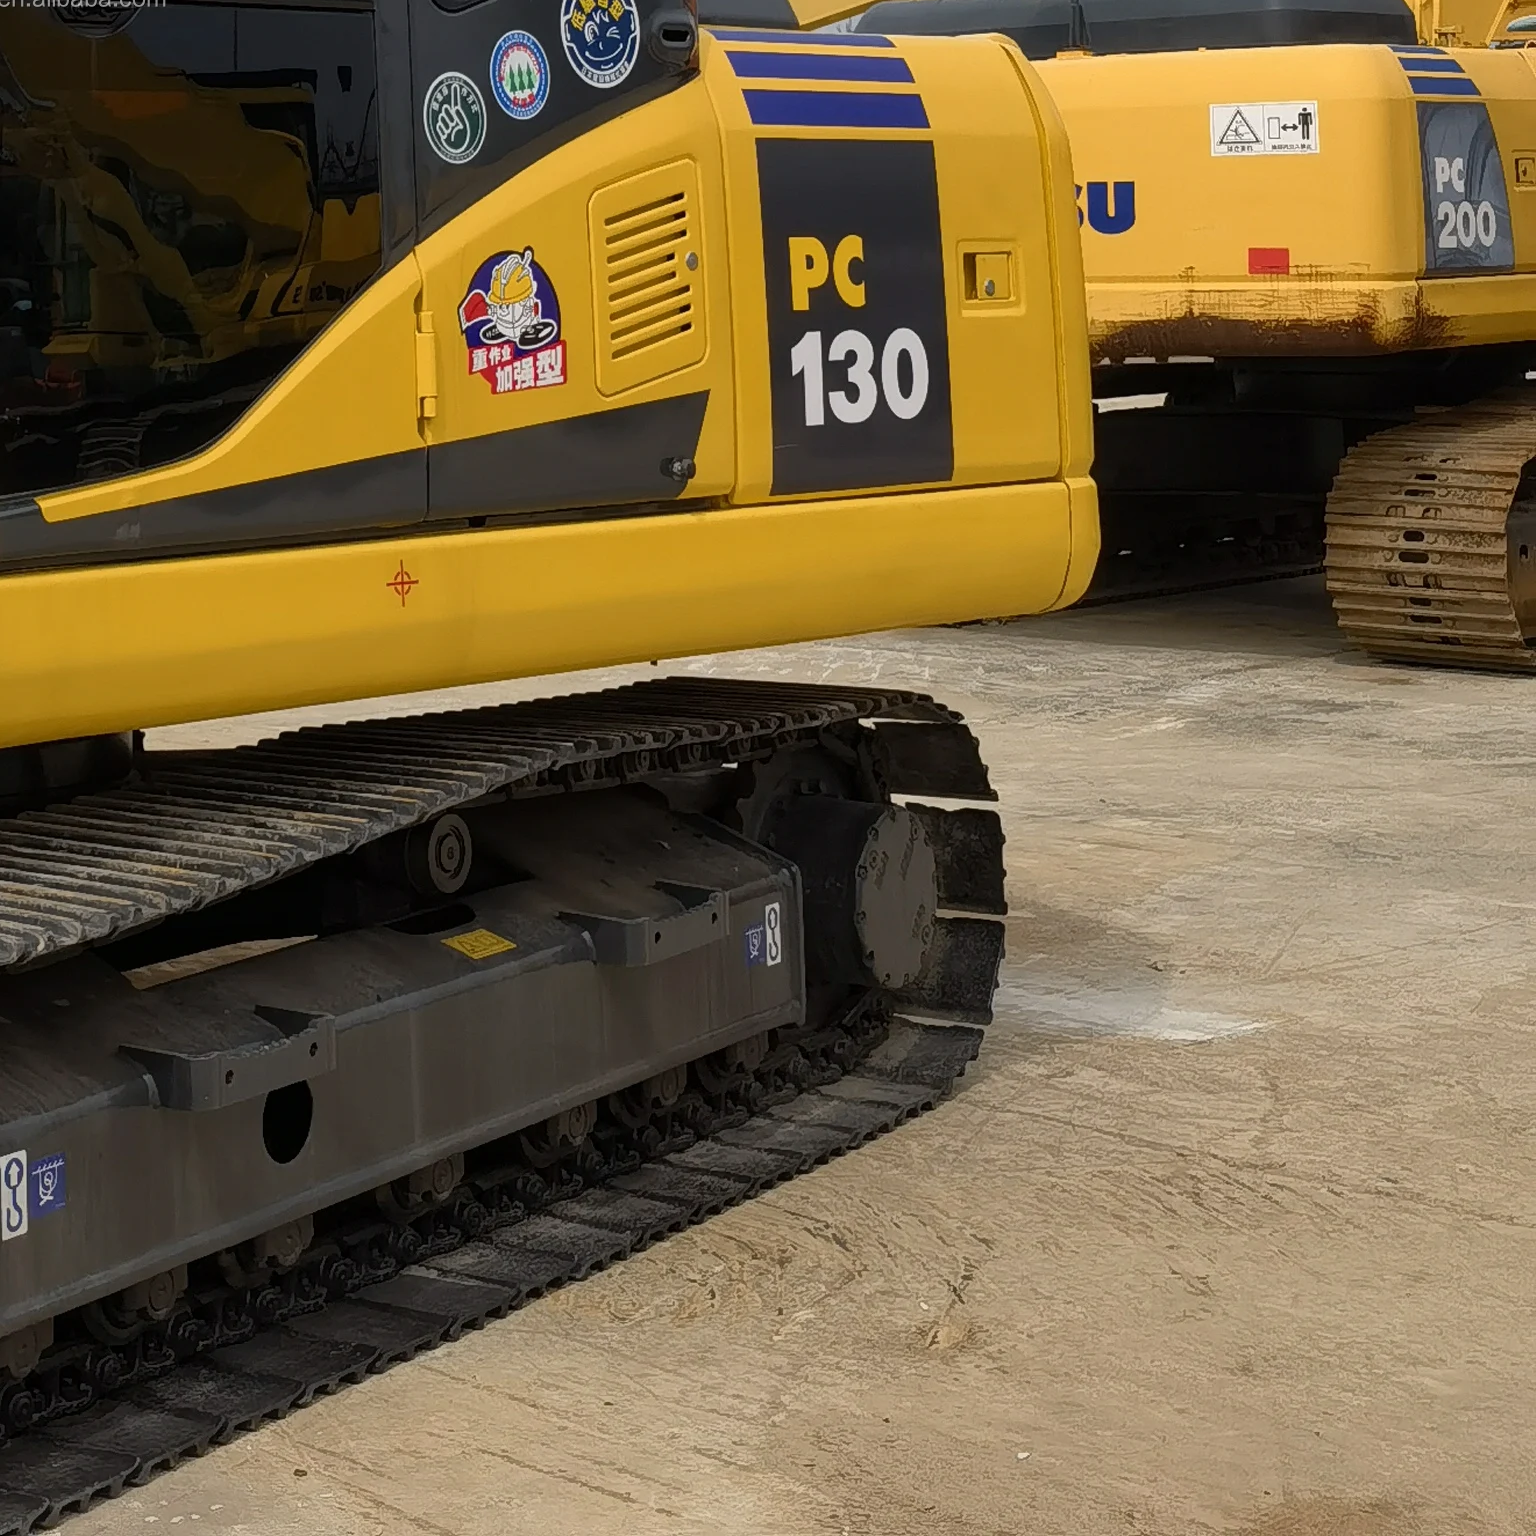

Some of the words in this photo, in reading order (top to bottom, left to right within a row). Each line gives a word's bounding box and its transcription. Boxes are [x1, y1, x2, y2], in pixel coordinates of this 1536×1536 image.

[1434, 156, 1465, 193] PC
[1074, 180, 1137, 235] U
[1436, 200, 1497, 249] 200
[788, 234, 866, 311] PC
[495, 344, 565, 393] 加强型
[790, 327, 930, 426] 130
